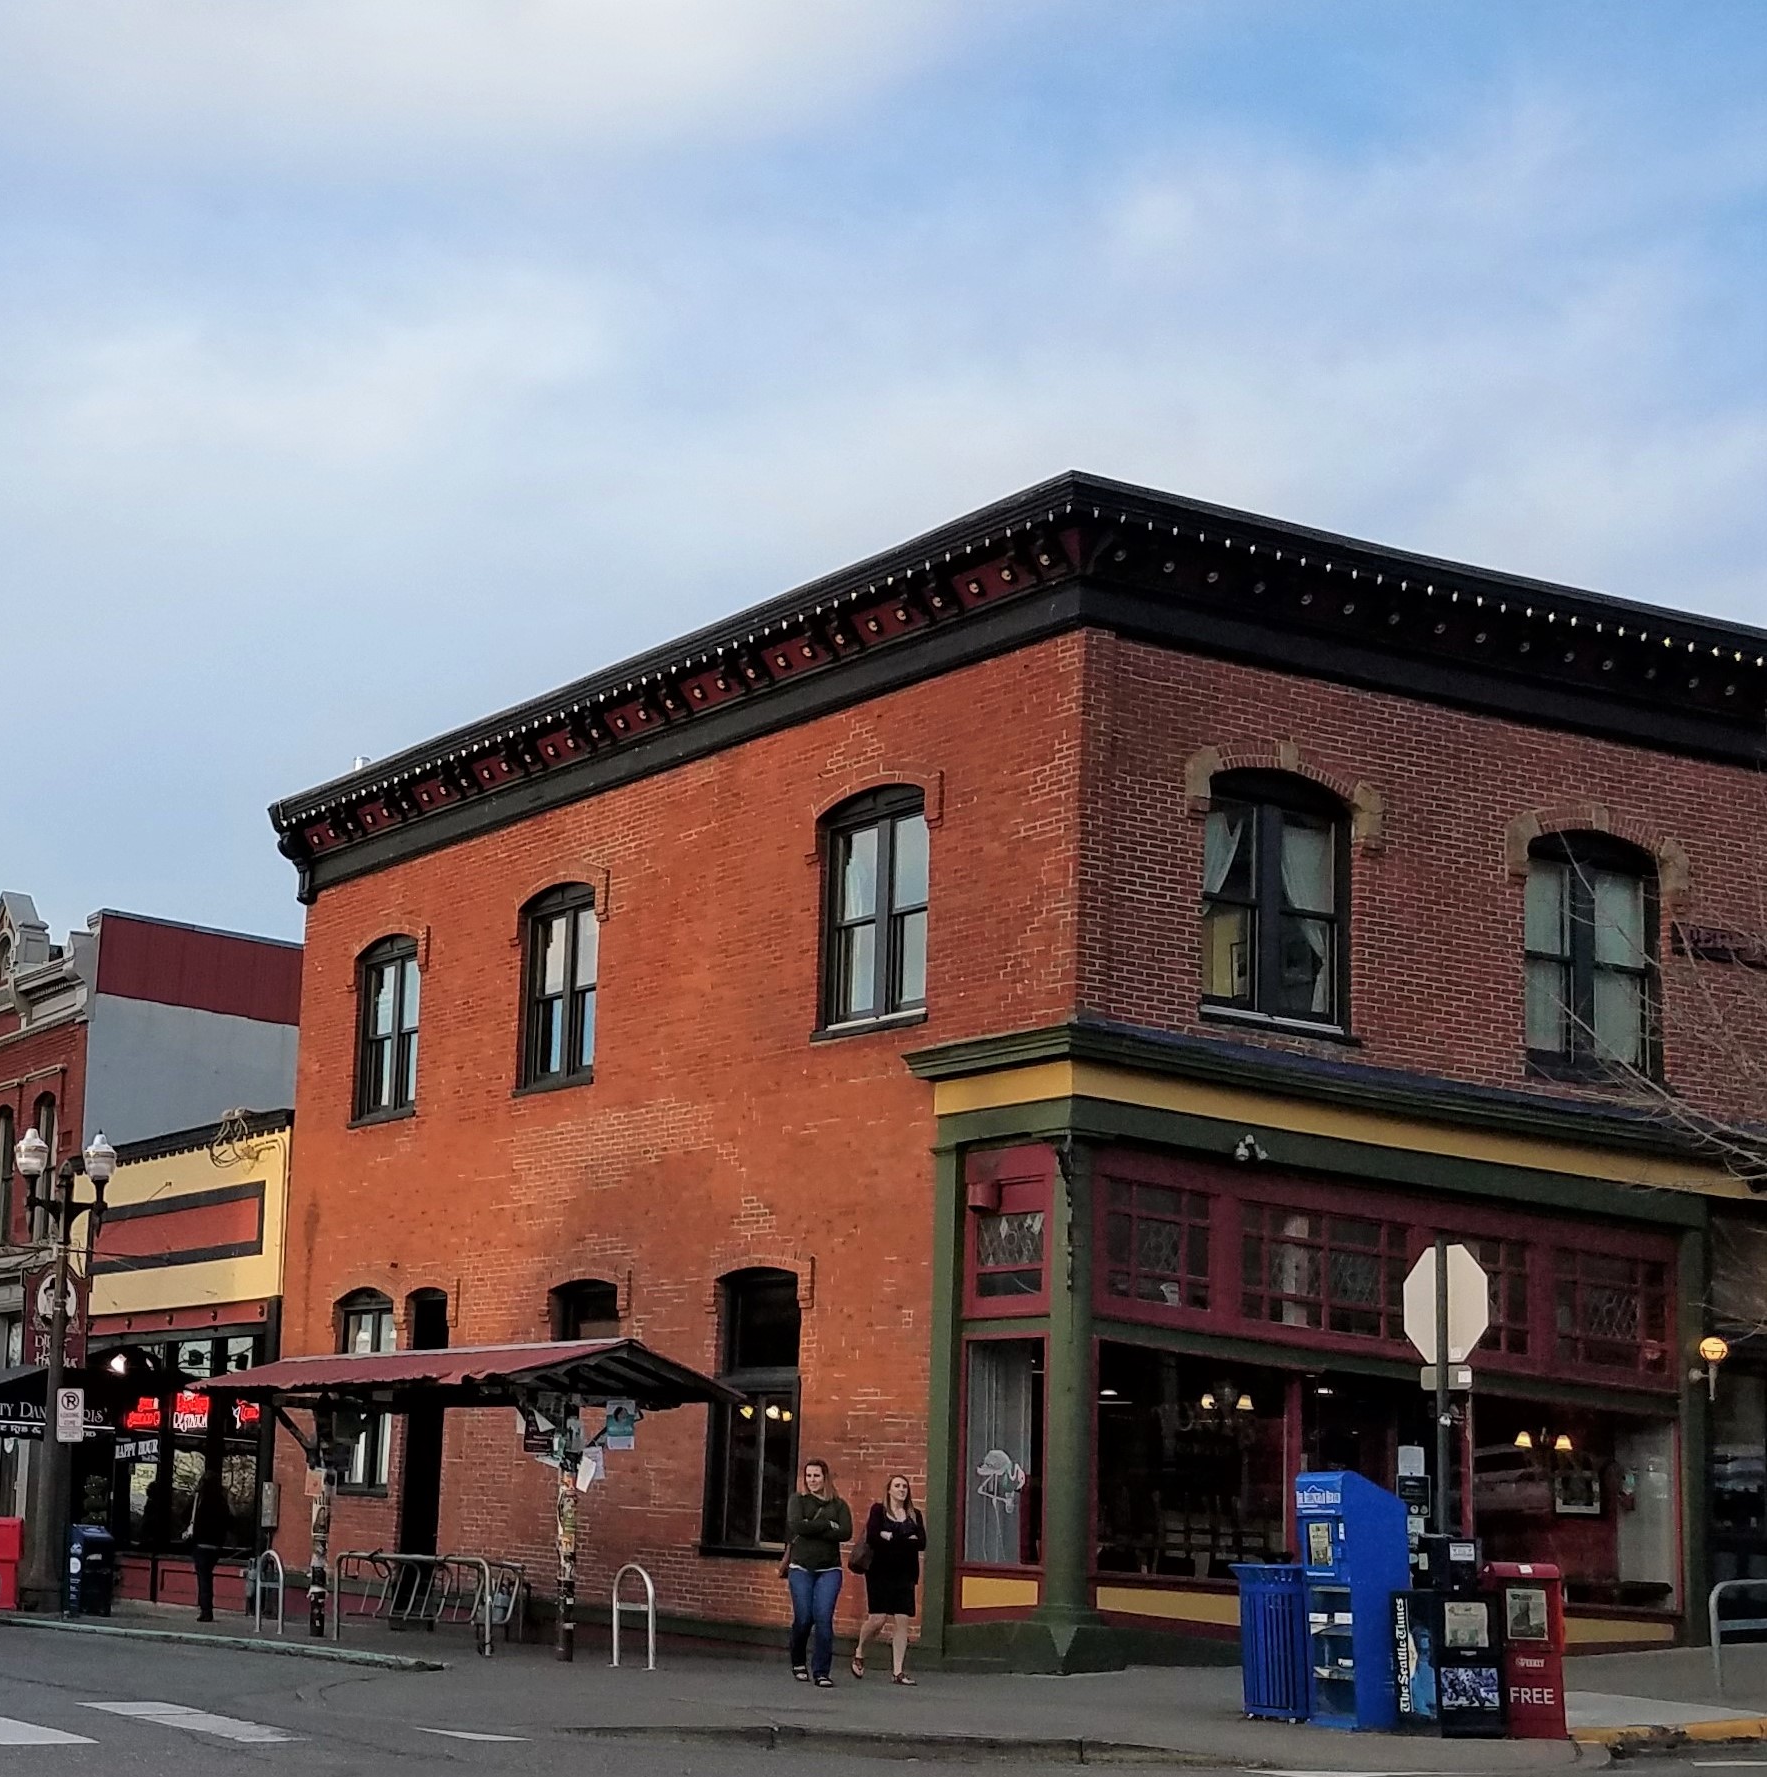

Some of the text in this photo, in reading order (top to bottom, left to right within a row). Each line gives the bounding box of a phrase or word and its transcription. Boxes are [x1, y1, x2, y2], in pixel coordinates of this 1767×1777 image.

[20, 1401, 47, 1419] DAN
[83, 1407, 108, 1423] RIS'
[10, 1425, 29, 1434] RIB
[31, 1426, 42, 1435] &
[1395, 1597, 1411, 1714] The Seattle Times
[1509, 1686, 1555, 1705] FREE
